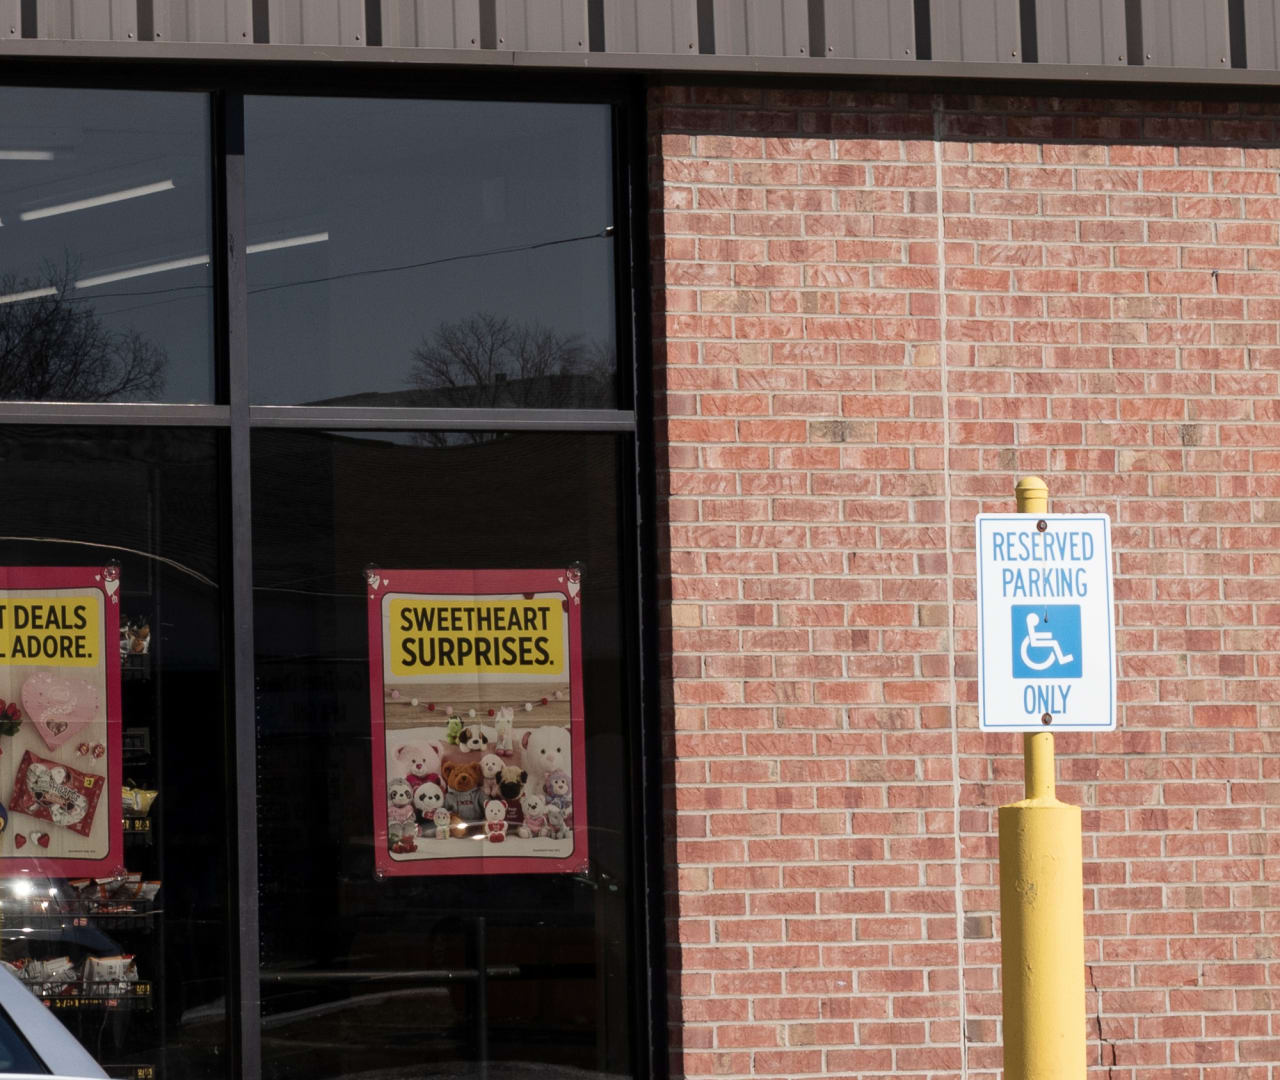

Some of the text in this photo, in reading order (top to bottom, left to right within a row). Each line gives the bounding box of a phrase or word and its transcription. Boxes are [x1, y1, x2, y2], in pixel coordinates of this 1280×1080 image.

[992, 532, 1094, 561] RESERVED
[1002, 568, 1088, 597] PARKING
[13, 604, 88, 630] DEALS
[400, 607, 551, 632] SWEETHEART
[11, 635, 93, 659] ADORE.
[401, 636, 555, 666] SURPRISES.
[1023, 684, 1072, 714] ONLY
